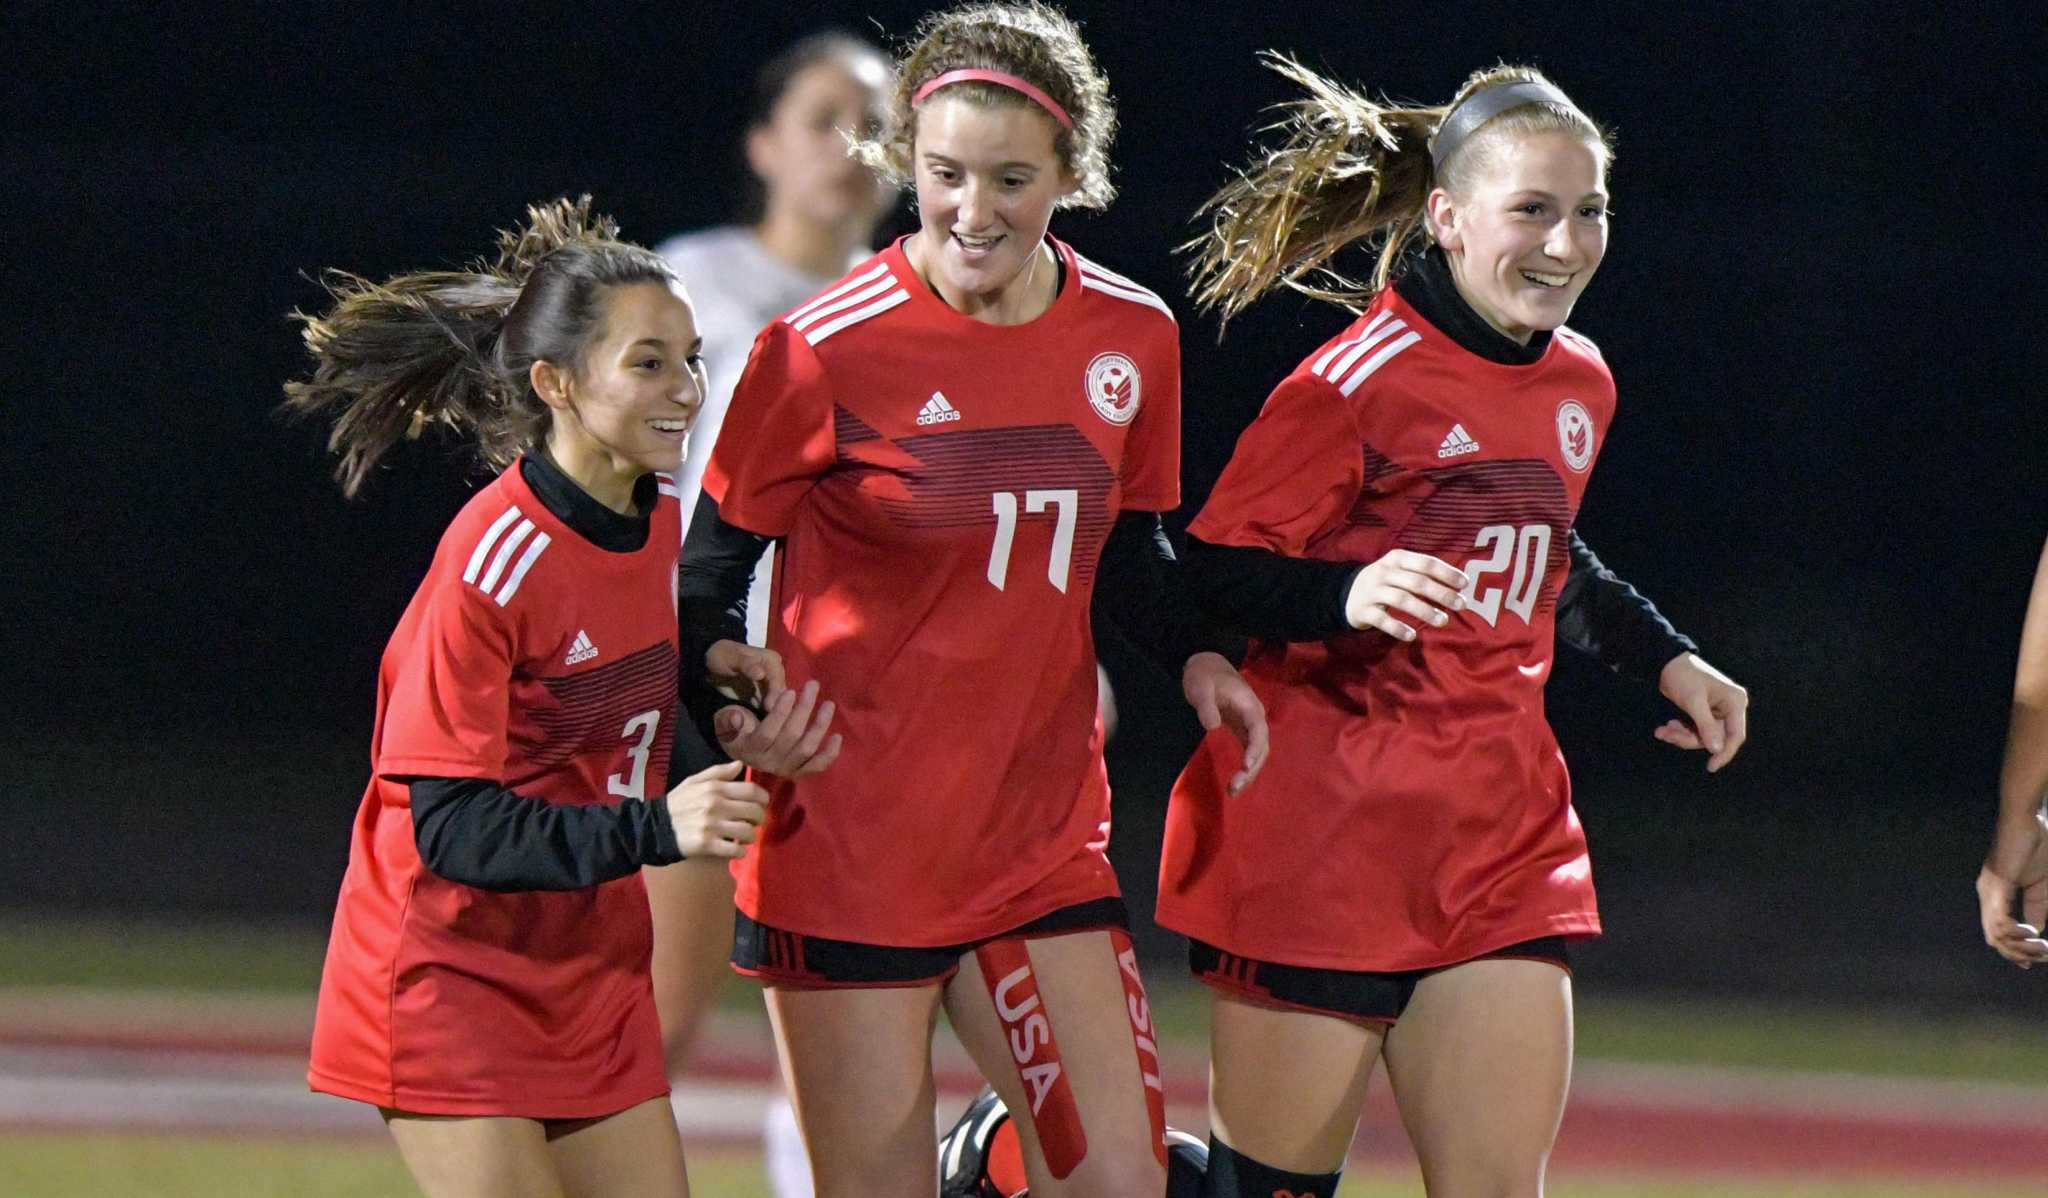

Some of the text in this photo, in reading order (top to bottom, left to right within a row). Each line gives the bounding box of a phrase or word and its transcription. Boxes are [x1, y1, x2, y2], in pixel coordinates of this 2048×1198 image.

[916, 410, 961, 425] adidas
[1438, 441, 1480, 458] adidas
[987, 489, 1078, 594] 17
[1460, 524, 1551, 628] 20
[564, 647, 598, 665] adidas
[607, 709, 660, 802] 3
[995, 965, 1061, 1117] USA
